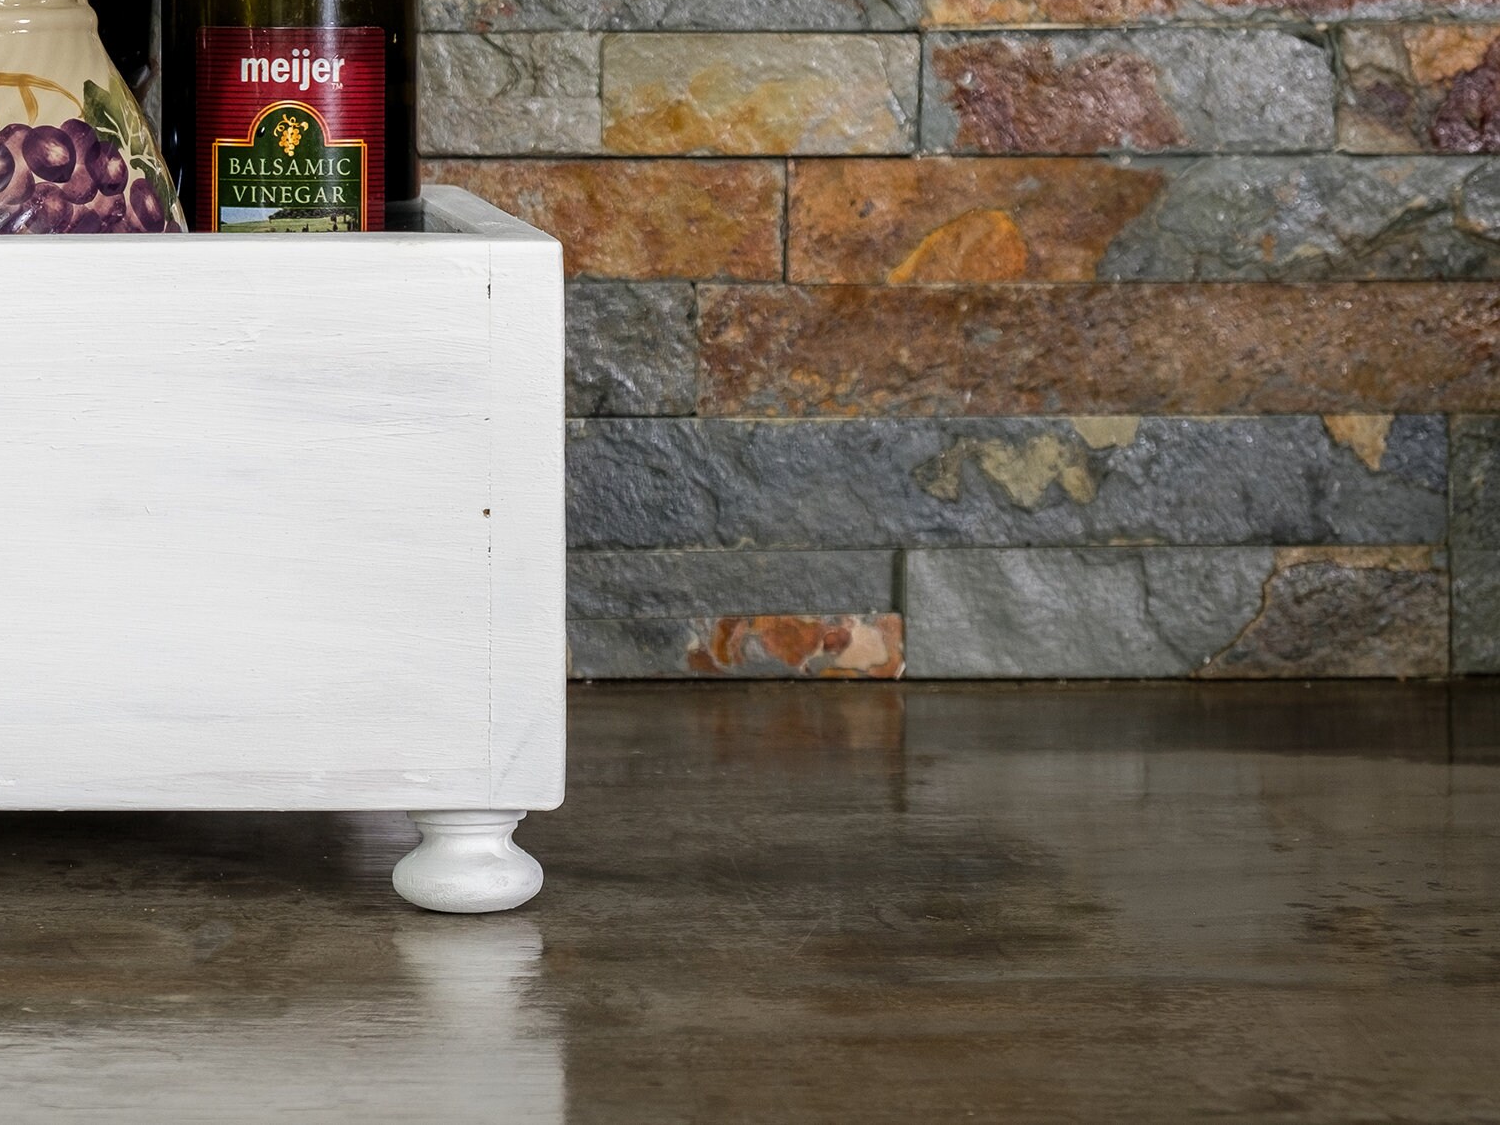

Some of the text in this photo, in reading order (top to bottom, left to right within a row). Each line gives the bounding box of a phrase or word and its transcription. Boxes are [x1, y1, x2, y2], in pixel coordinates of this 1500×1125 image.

[241, 48, 345, 91] meijer
[229, 157, 351, 176] BALSAMIC
[232, 185, 346, 204] VINEGAR
